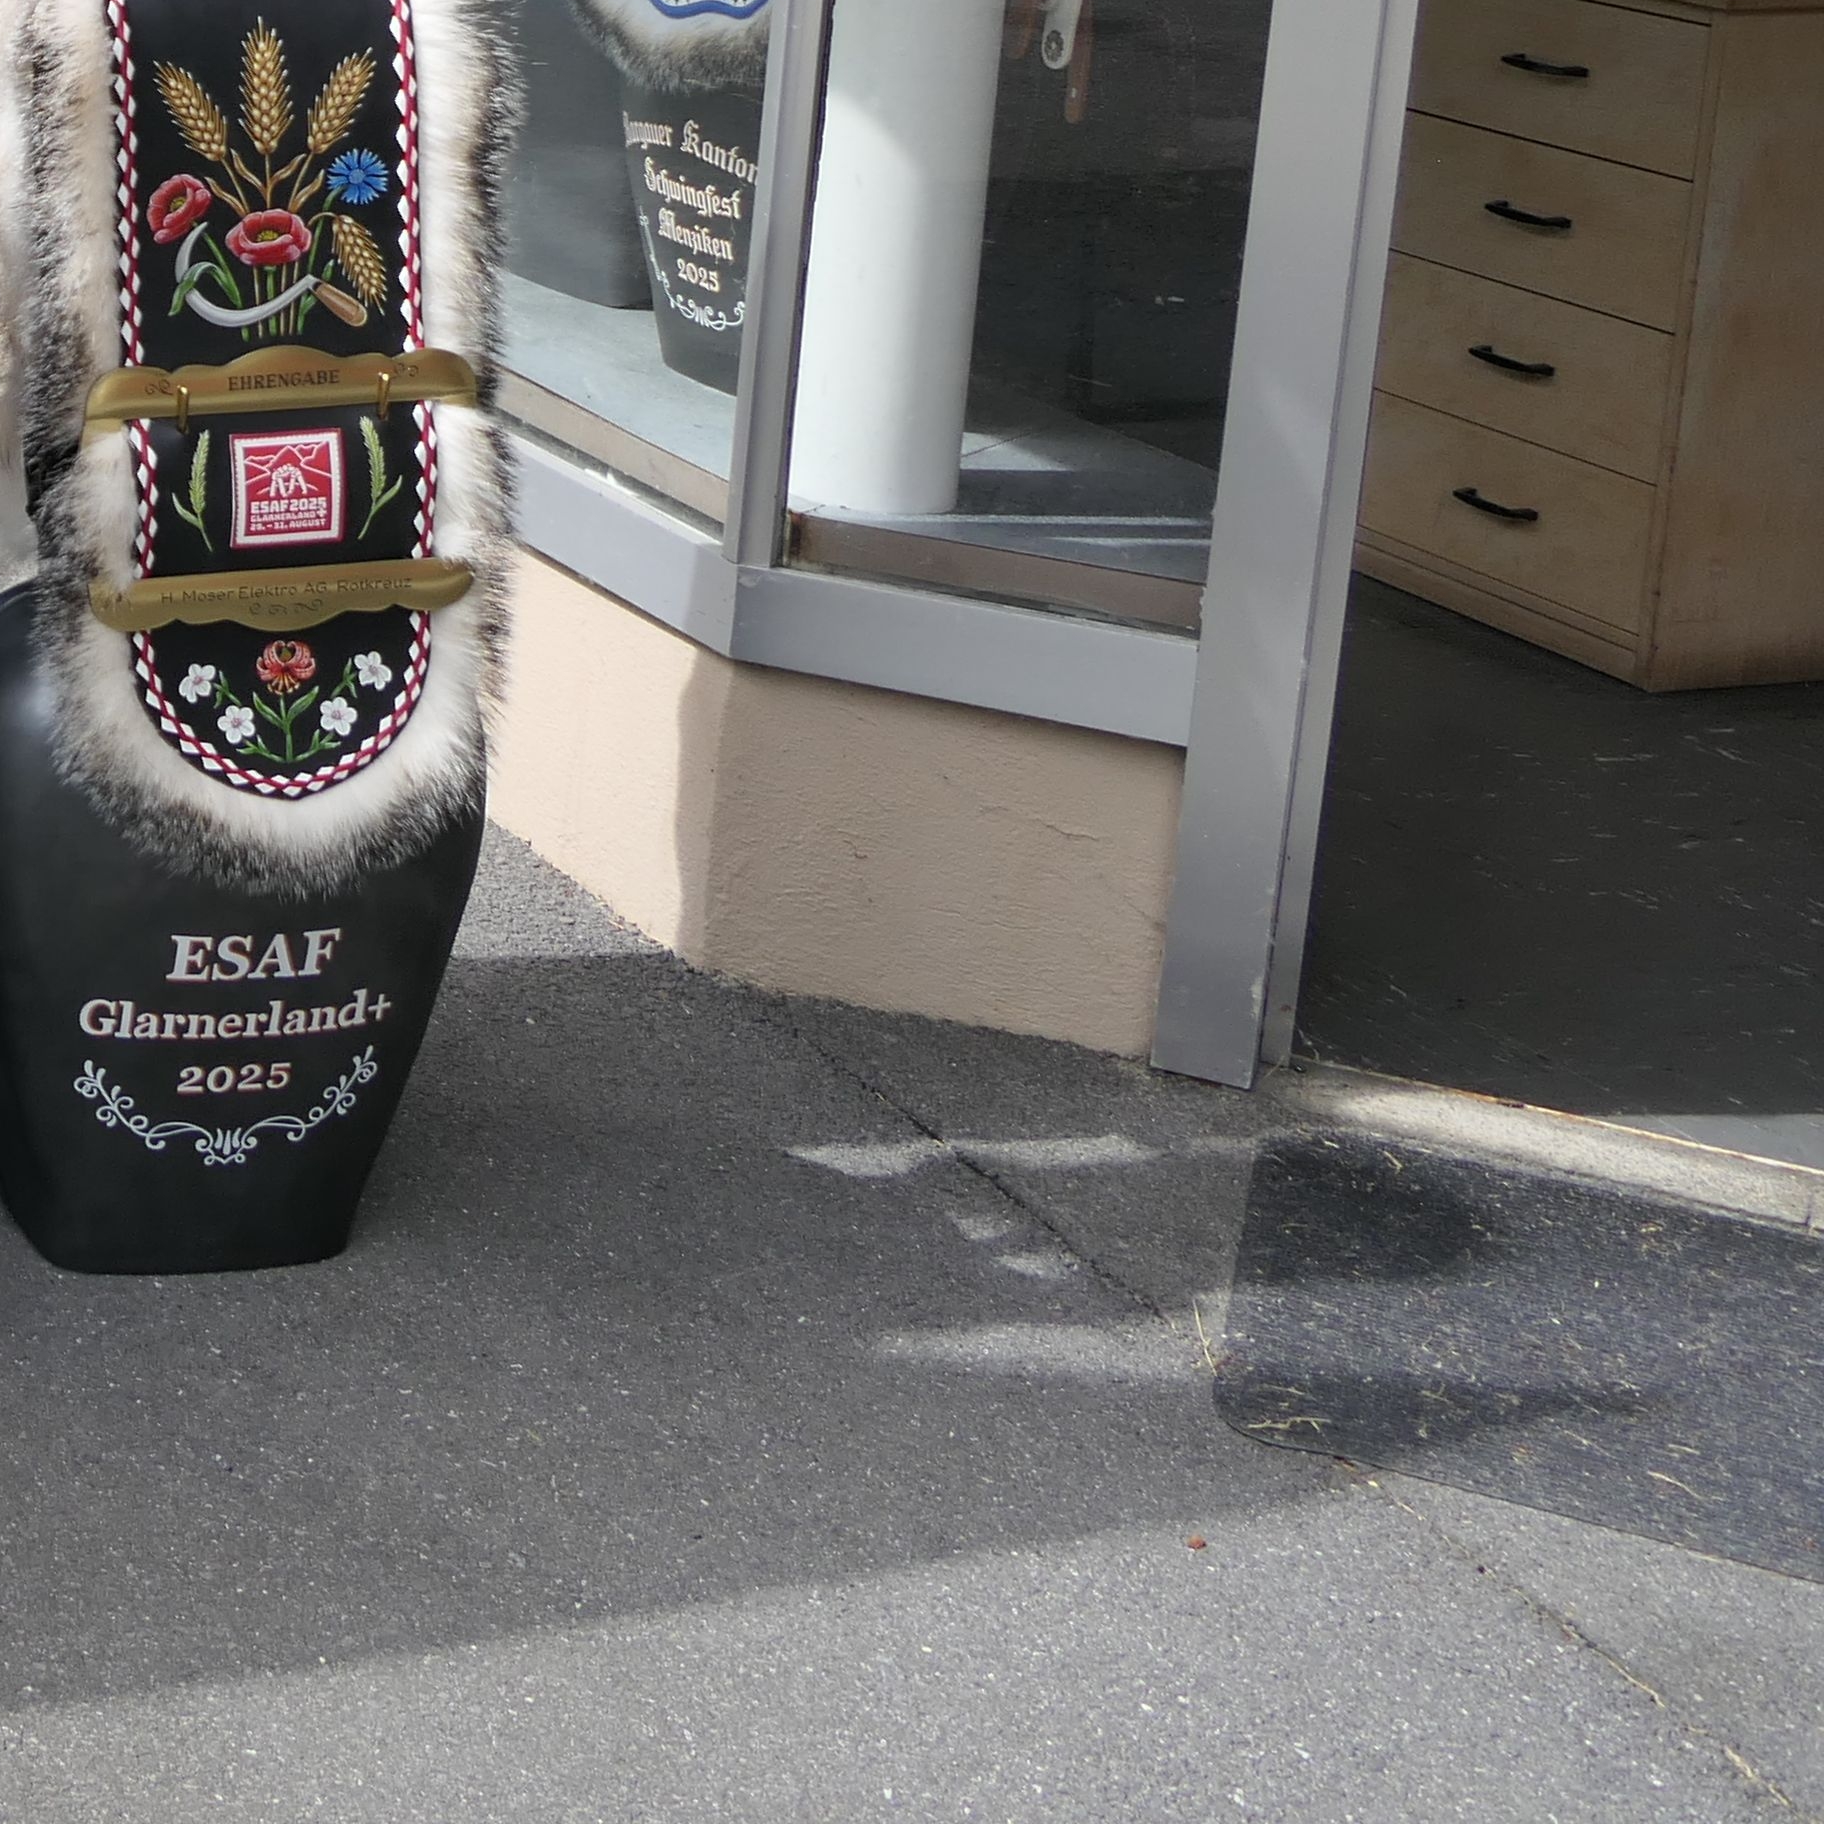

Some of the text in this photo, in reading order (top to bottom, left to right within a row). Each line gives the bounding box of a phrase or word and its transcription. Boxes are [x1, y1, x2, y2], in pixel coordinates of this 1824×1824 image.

[643, 156, 742, 219] Schwingfest
[658, 207, 734, 261] Menziken
[676, 257, 721, 293] 2025
[228, 369, 341, 392] EHRENGABE
[250, 497, 327, 514] ESAF 2025
[289, 518, 326, 528] AUGUST
[182, 587, 236, 603] Moser
[238, 585, 299, 600] Elektro
[337, 576, 414, 593] Rotkreuz
[165, 927, 343, 983] ESAF
[176, 1062, 292, 1095] 2025
